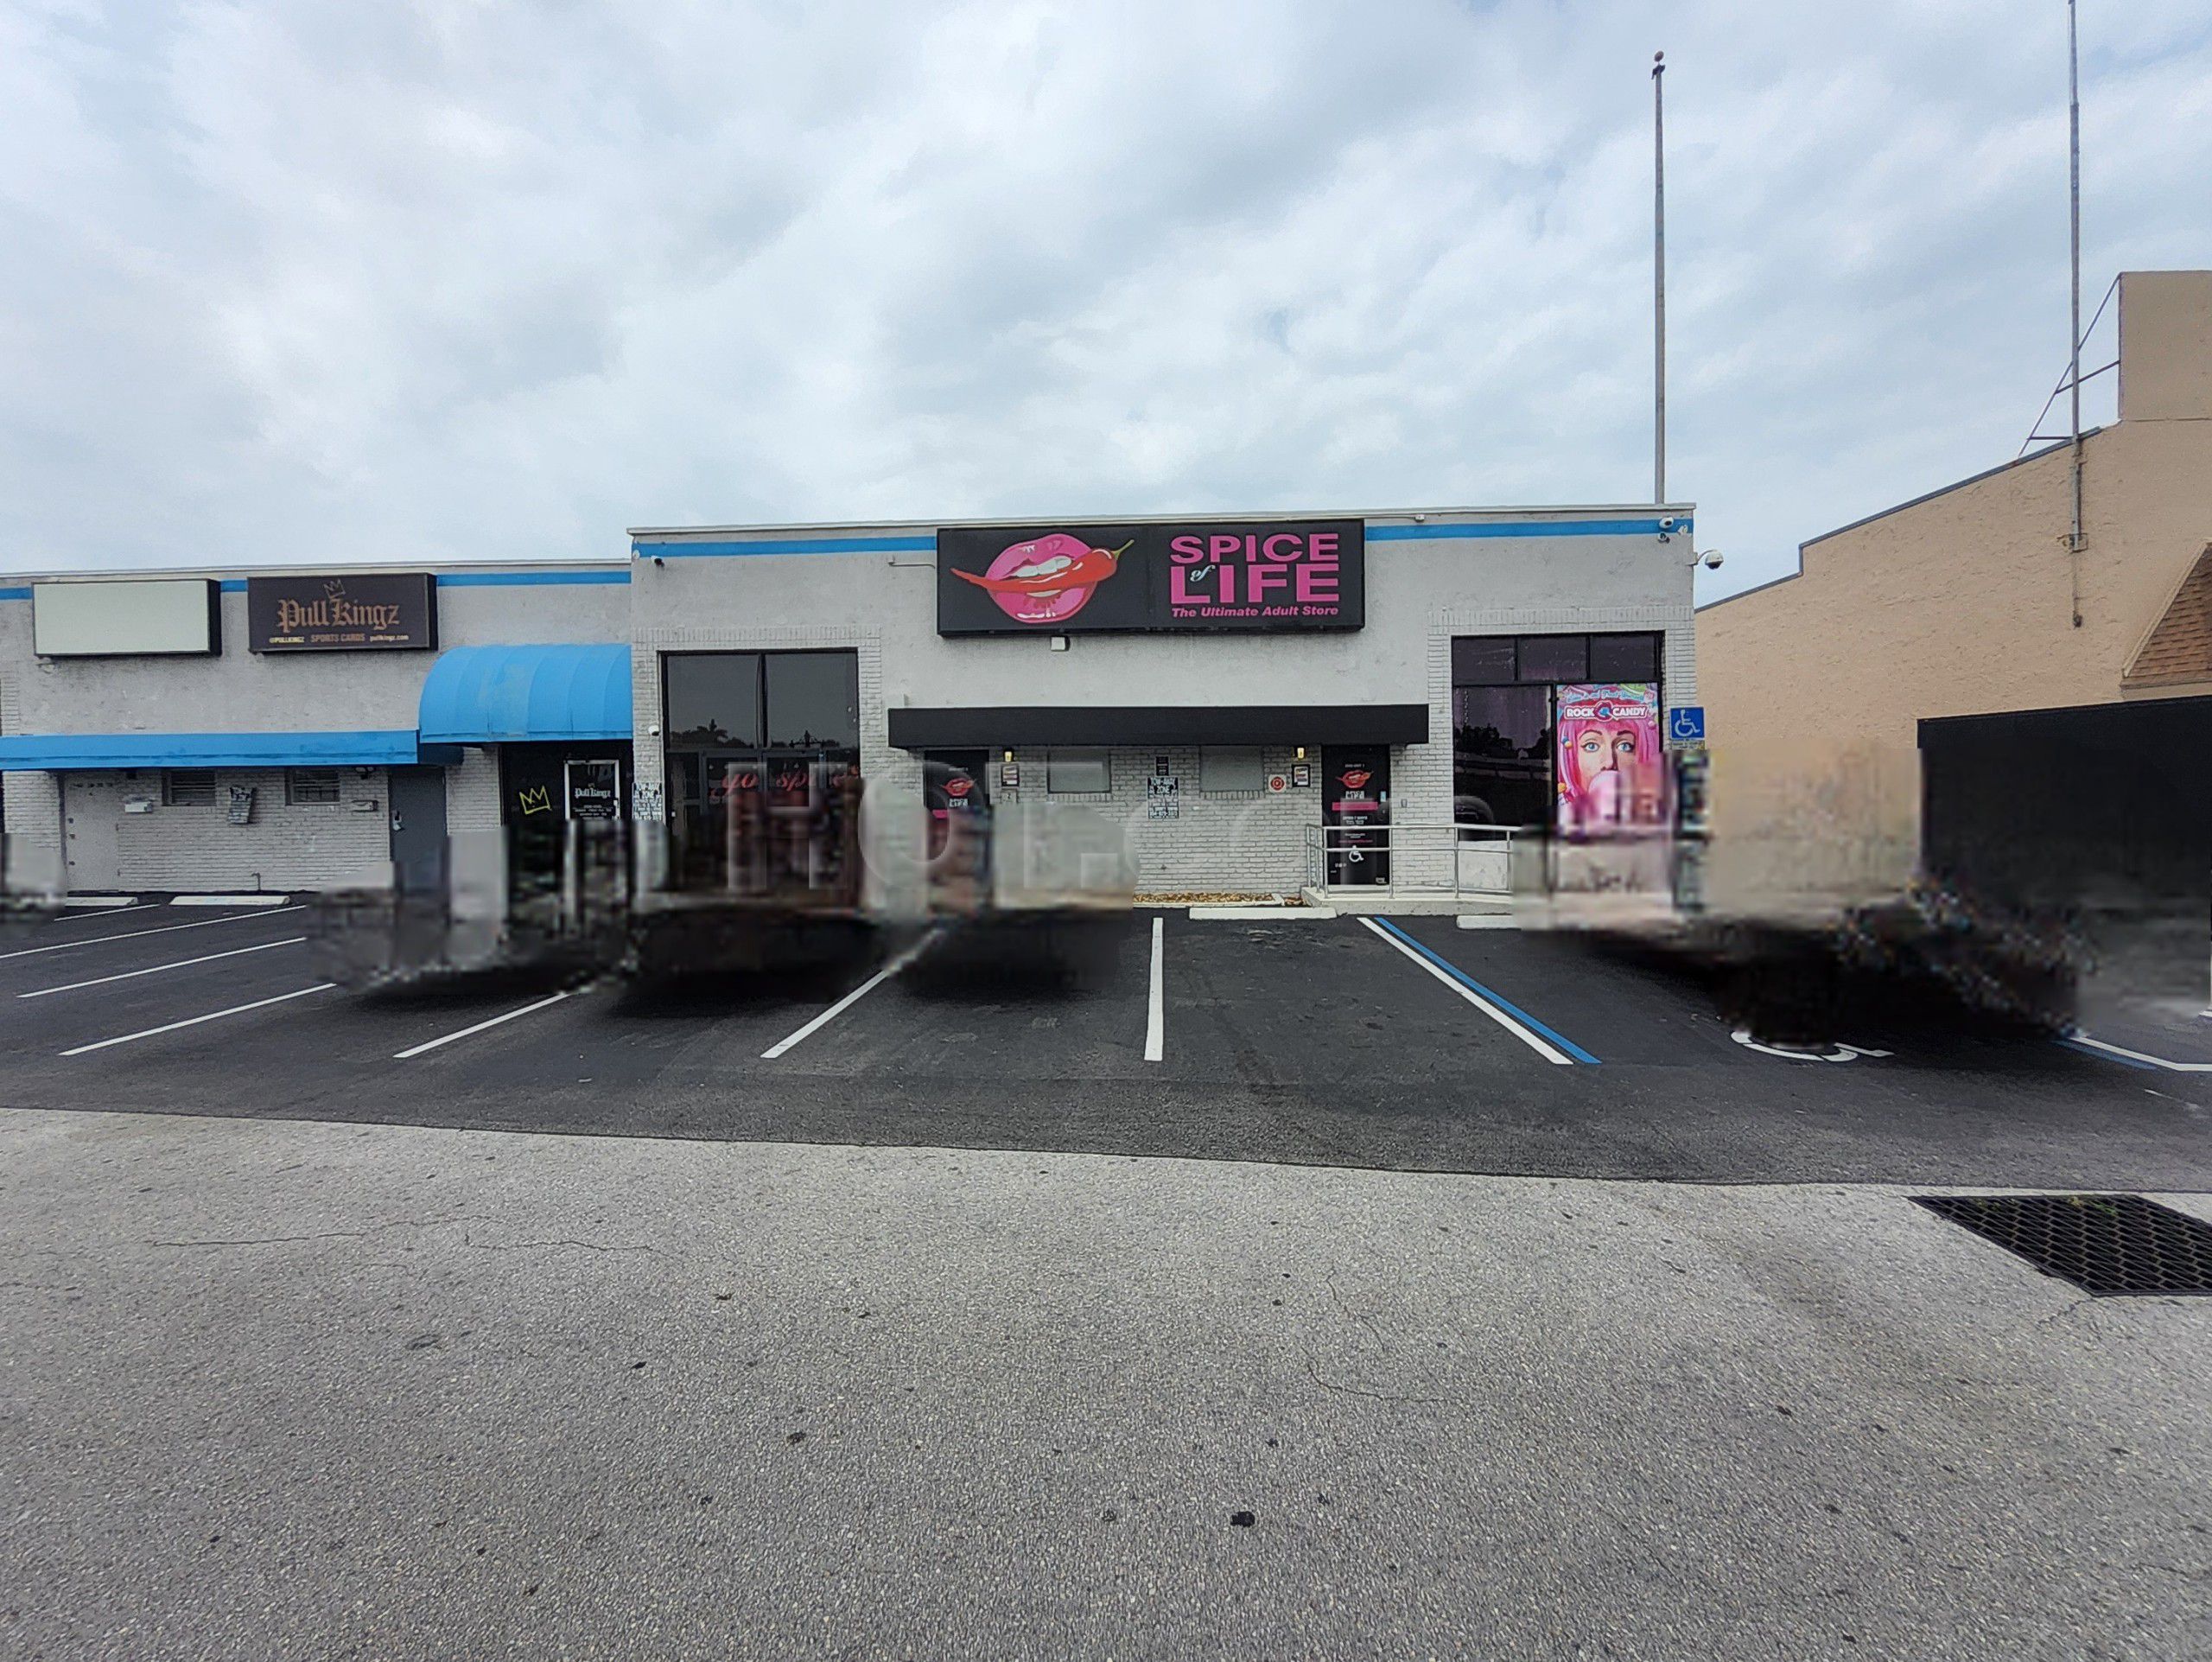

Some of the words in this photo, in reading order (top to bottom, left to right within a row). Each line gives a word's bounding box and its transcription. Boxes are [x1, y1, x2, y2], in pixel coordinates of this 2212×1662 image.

[1170, 533, 1339, 564] SPICE
[1190, 564, 1216, 583] of
[1170, 563, 1339, 604] LIFE
[276, 598, 329, 634] Pull
[330, 598, 400, 631] Kingz
[1172, 608, 1197, 618] The
[1201, 606, 1259, 617] Ultimate
[1262, 605, 1299, 616] Adult
[1302, 605, 1339, 615] Store
[310, 634, 340, 642] SPORTS
[340, 633, 365, 642] CARDS
[1566, 708, 1595, 717] ROCK
[1612, 707, 1646, 716] CANDY
